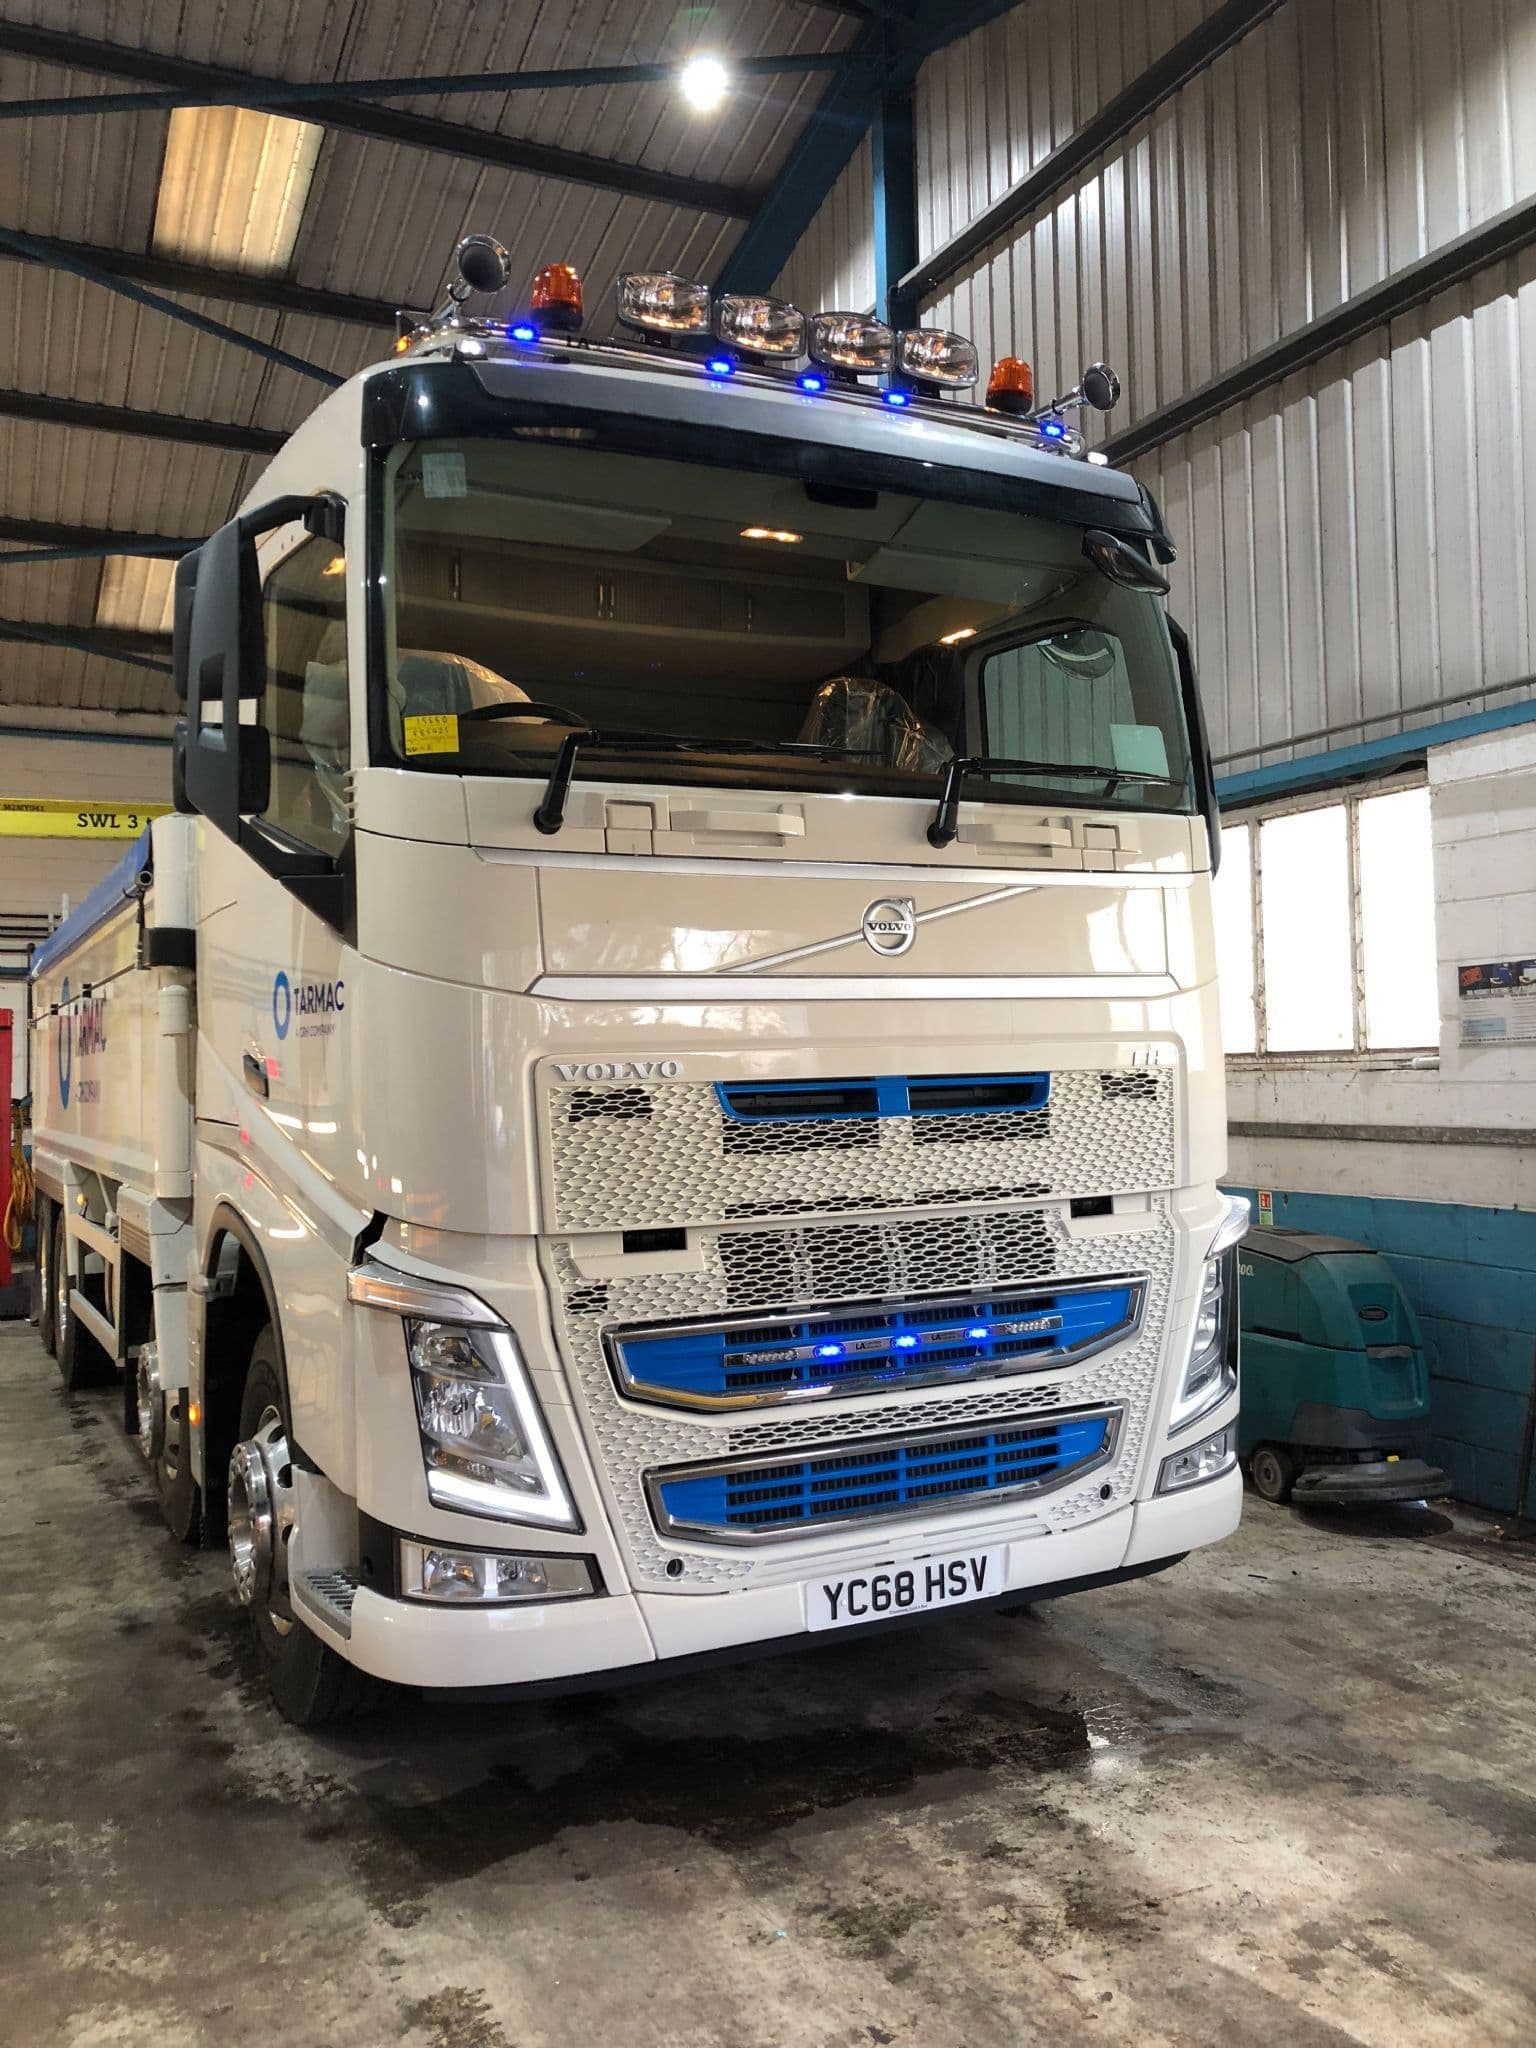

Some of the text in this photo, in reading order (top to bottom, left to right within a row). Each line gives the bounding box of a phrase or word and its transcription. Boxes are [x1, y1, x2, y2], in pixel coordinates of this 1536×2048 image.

[77, 812, 138, 829] SWL 3
[866, 921, 911, 931] VOLVO
[294, 981, 344, 1015] TARMAC
[553, 1059, 683, 1082] VOLVO
[823, 1555, 988, 1620] YC68 HSV
